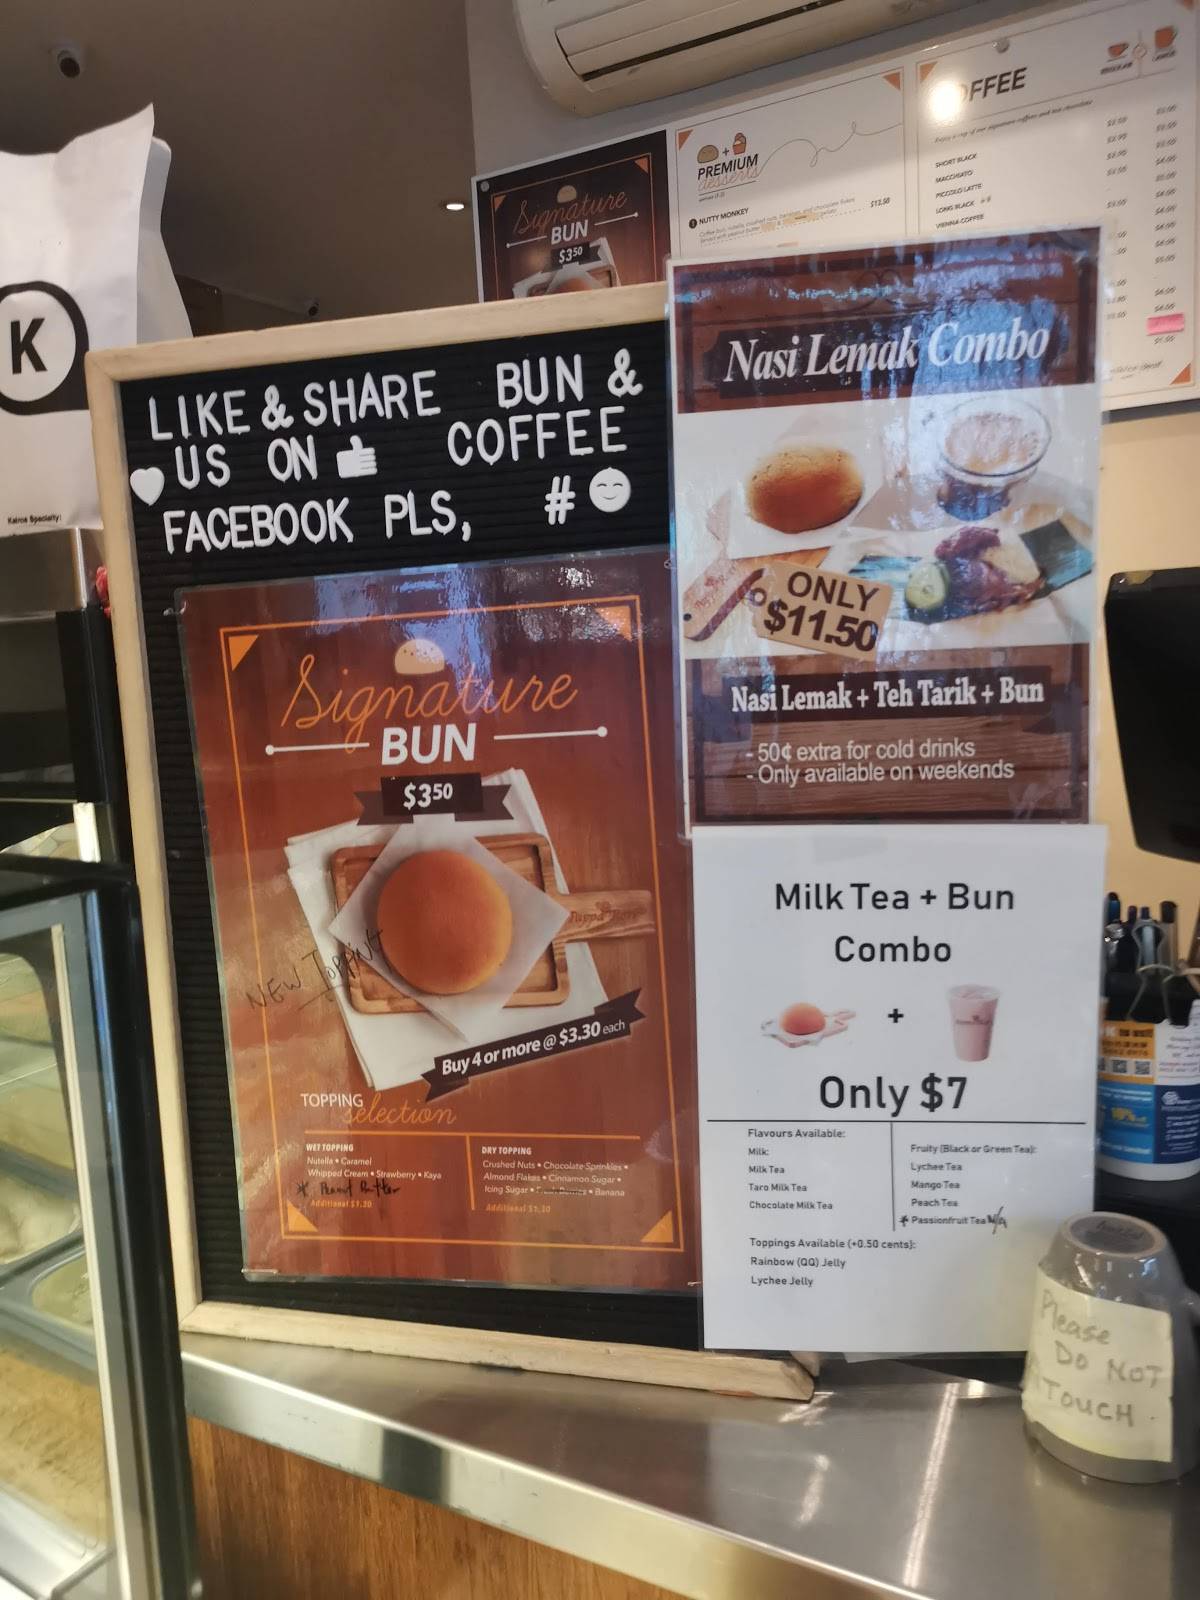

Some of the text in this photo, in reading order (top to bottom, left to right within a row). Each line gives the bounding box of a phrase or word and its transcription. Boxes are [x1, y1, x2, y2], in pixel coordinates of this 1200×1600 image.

[697, 153, 759, 181] PREMIUM
[935, 153, 977, 169] SHORT BLACK
[935, 169, 973, 184] MACCHIATO
[963, 182, 982, 194] LATTE
[513, 192, 628, 236] Signature
[699, 207, 749, 225] NUTTY MONKEY
[935, 200, 975, 215] LONG BLACK
[935, 213, 985, 230] VIENNA COFFEE
[551, 219, 589, 245] BUN
[10, 317, 48, 375] K
[723, 318, 1051, 383] Nasi Lemak Combo
[496, 347, 643, 409] BUN &
[148, 369, 442, 442] LIKE & SHARE
[447, 405, 628, 467] COFFEE
[174, 434, 318, 490] US ON
[544, 474, 576, 526] #
[162, 489, 472, 555] FACEBOOK PLS,
[787, 571, 880, 612] ONLY
[763, 598, 879, 652] $11.50
[731, 676, 1044, 713] Nasi Lemak + Teh Tarik + Bun
[281, 653, 579, 755] Signature
[381, 723, 478, 766] BUN
[758, 742, 792, 764] 50¢
[796, 743, 842, 761] extra
[846, 740, 871, 760] for
[876, 738, 914, 760] cold
[919, 737, 976, 759] drinks
[758, 763, 799, 788] Only
[804, 761, 885, 784] available
[890, 765, 913, 781] on
[917, 759, 1015, 780] weekends
[775, 882, 1015, 910] Milk Tea + Bun
[834, 935, 952, 963] Combo
[246, 964, 301, 1010] NEW
[442, 1019, 626, 1076] Buy 4 or more @ $3.30 each
[300, 1093, 364, 1108] TOPPING
[820, 1073, 968, 1118] Only $7
[343, 1092, 457, 1125] selection
[748, 1129, 846, 1138] Flavours Available:
[306, 1143, 353, 1152] WET TOPPING
[481, 1146, 532, 1155] DRY TOPPING
[748, 1148, 769, 1156] Milk:
[911, 1144, 938, 1154] Fruity
[940, 1144, 969, 1154] (Black
[983, 1145, 1013, 1154] Green
[1014, 1144, 1038, 1154] Tea):
[307, 1157, 372, 1166] Nutella Caramel
[482, 1160, 622, 1172] Crushed Nuts Chocolate Sprinkles
[749, 1166, 785, 1174] Milk Tea
[911, 1162, 963, 1173] Lychee Tea
[307, 1169, 442, 1181] Whipped Cream Strawberry Kaya
[483, 1172, 616, 1185] Almond Flakes Cinnamon Sugar
[484, 1185, 503, 1195] Icing
[505, 1186, 528, 1196] Sugar
[594, 1188, 625, 1197] Banana
[749, 1184, 808, 1192] Taro Milk Tea
[911, 1181, 960, 1190] Mango Tea
[749, 1201, 833, 1210] Chocolate Milk Tea
[911, 1199, 958, 1207] Peach Tea
[911, 1216, 987, 1225] Passionfruit Tea
[749, 1238, 917, 1249] Toppings Available (+0.50 cents):
[750, 1257, 846, 1269] Rainbow (QQ) Jelly
[751, 1276, 814, 1288] Lychee Jelly
[1040, 1290, 1111, 1346] Please
